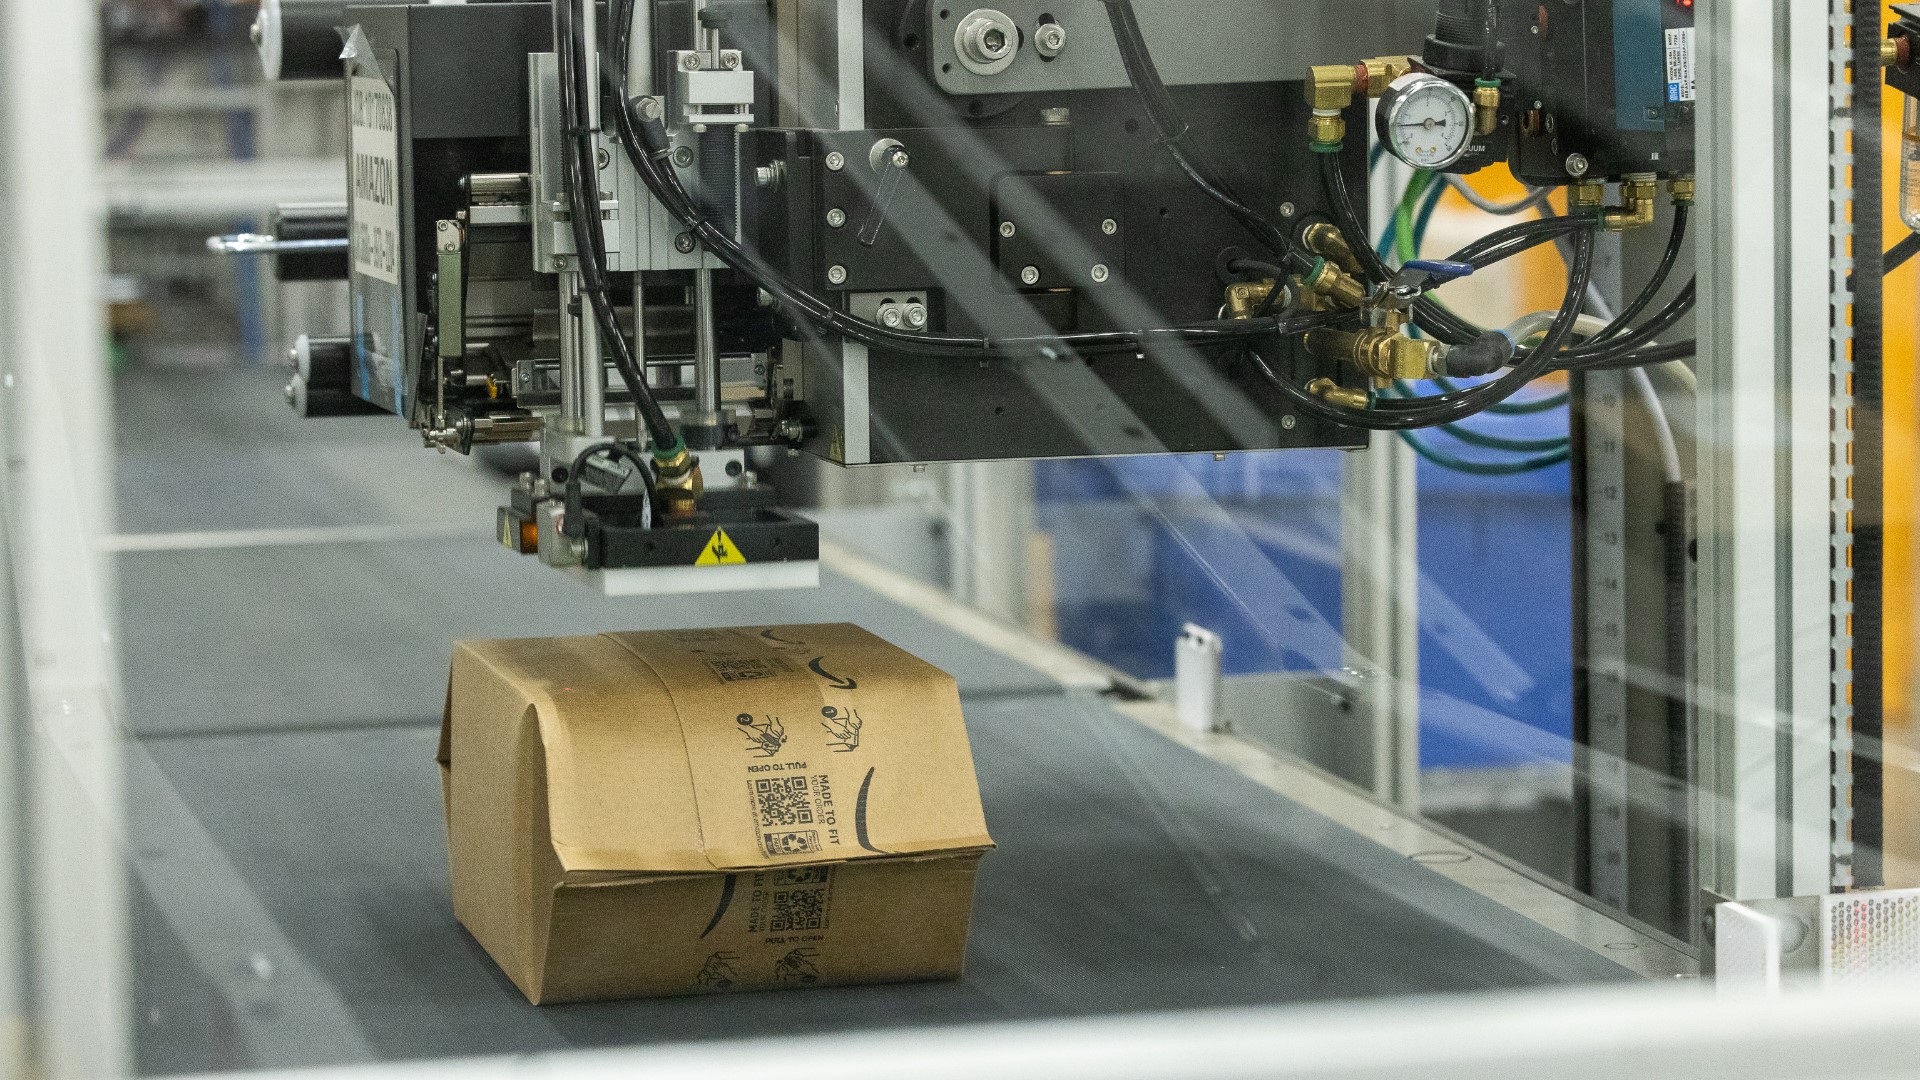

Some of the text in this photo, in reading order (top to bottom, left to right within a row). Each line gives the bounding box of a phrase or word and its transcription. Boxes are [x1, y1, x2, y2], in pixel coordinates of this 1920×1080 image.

[355, 153, 393, 207] AMAZON
[747, 761, 807, 773] PULL TO OPEN
[811, 775, 821, 797] YOUR
[814, 798, 826, 825] ORDER
[818, 774, 840, 845] MADE TO FIT
[751, 889, 763, 902] TO
[747, 905, 760, 933] MADE
